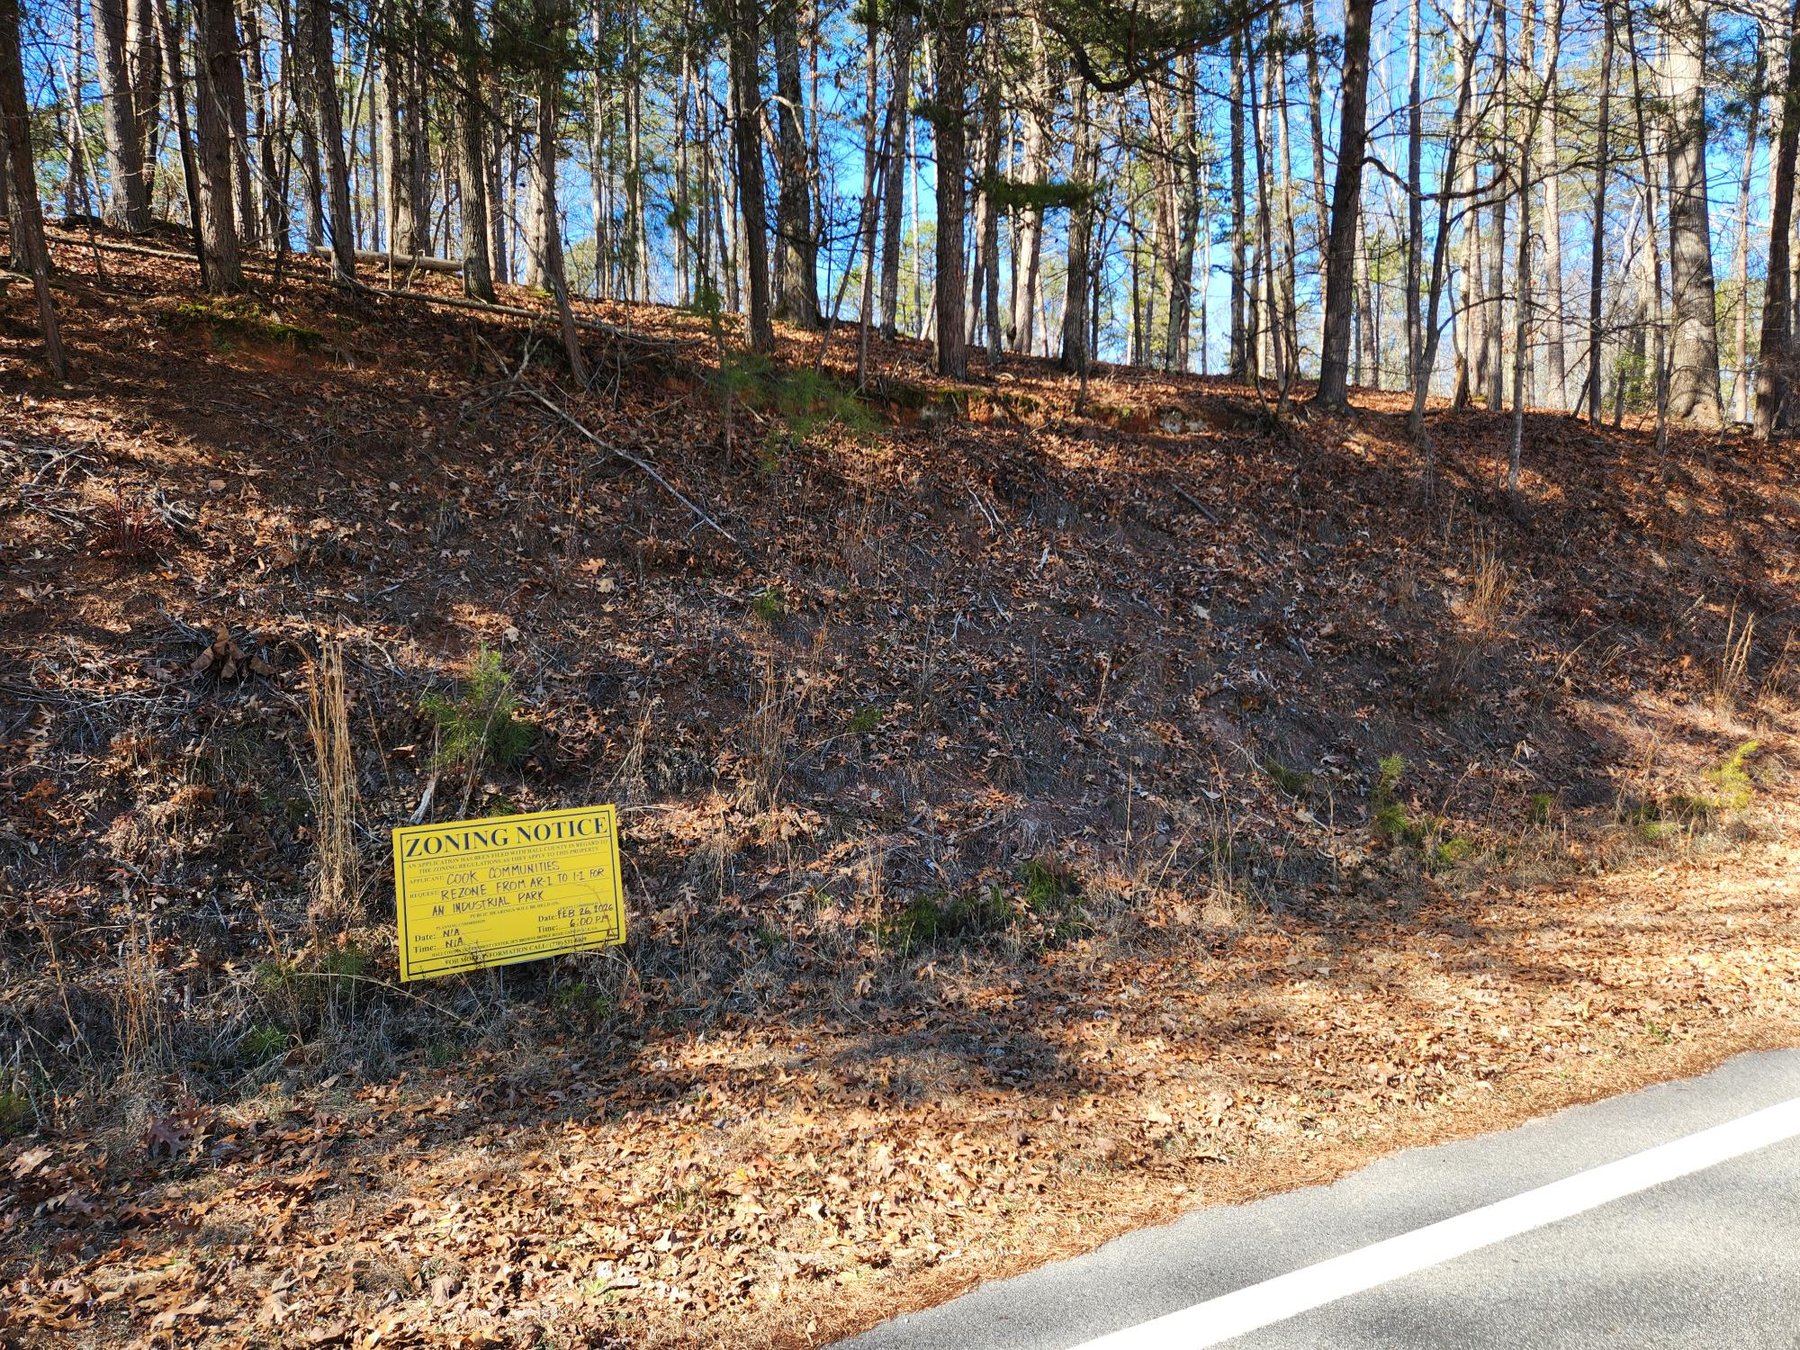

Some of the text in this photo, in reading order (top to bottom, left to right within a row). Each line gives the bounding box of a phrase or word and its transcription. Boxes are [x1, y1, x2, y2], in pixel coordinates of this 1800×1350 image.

[406, 817, 608, 857] ZONING NOTICE
[418, 858, 459, 868] APPLICATION
[459, 859, 501, 869] REGULATIONS
[409, 861, 560, 886] APPLICANT: COOK COMMUNITIES
[441, 884, 487, 901] REZONE
[496, 879, 526, 894] FROM
[557, 873, 568, 883] TO
[589, 868, 604, 879] FOR
[432, 890, 544, 917] AN INDUSTRIAL PARK
[538, 914, 558, 922] Date:
[557, 909, 575, 919] FEB
[594, 903, 614, 913] 2026
[538, 925, 559, 933] Time:
[569, 917, 593, 928] 6:00
[414, 928, 460, 942] Date: N/A
[413, 944, 436, 954] Time:
[445, 937, 464, 948] N/A
[461, 954, 480, 963] MOR
